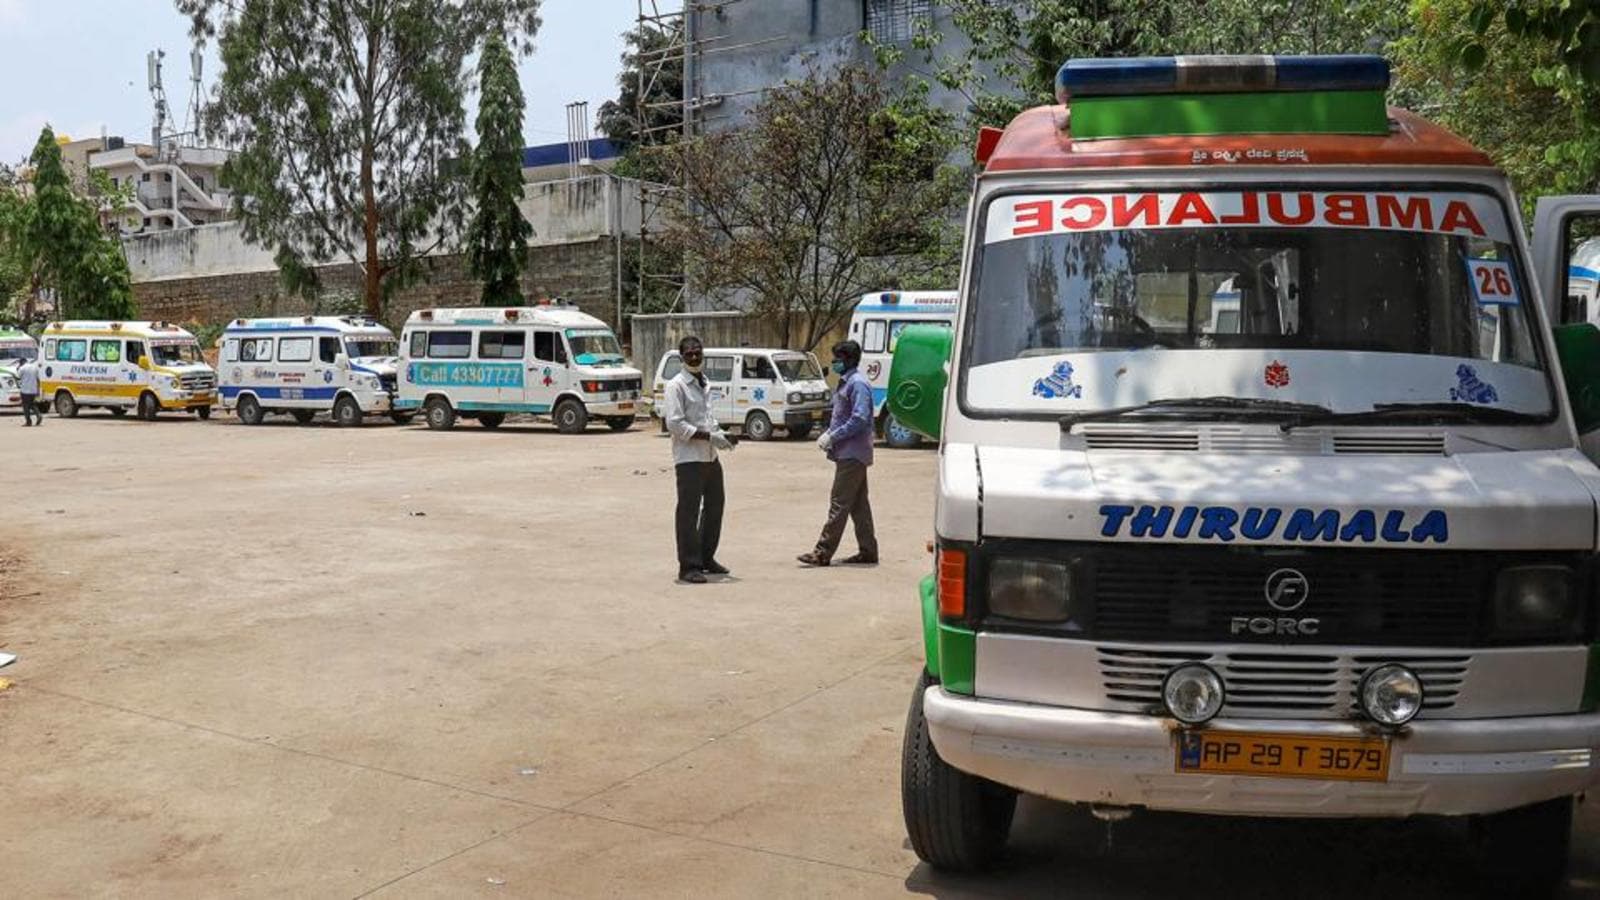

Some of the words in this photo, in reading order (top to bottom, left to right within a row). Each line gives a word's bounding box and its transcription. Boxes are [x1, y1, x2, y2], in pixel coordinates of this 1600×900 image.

[1476, 266, 1512, 296] 26
[420, 366, 448, 382] Call
[1098, 504, 1450, 543] THIRUMALA
[1231, 617, 1321, 635] FORC
[1203, 741, 1241, 764] AP
[1251, 743, 1283, 766] 29
[1293, 746, 1309, 767] T
[1320, 747, 1382, 771] 3679
